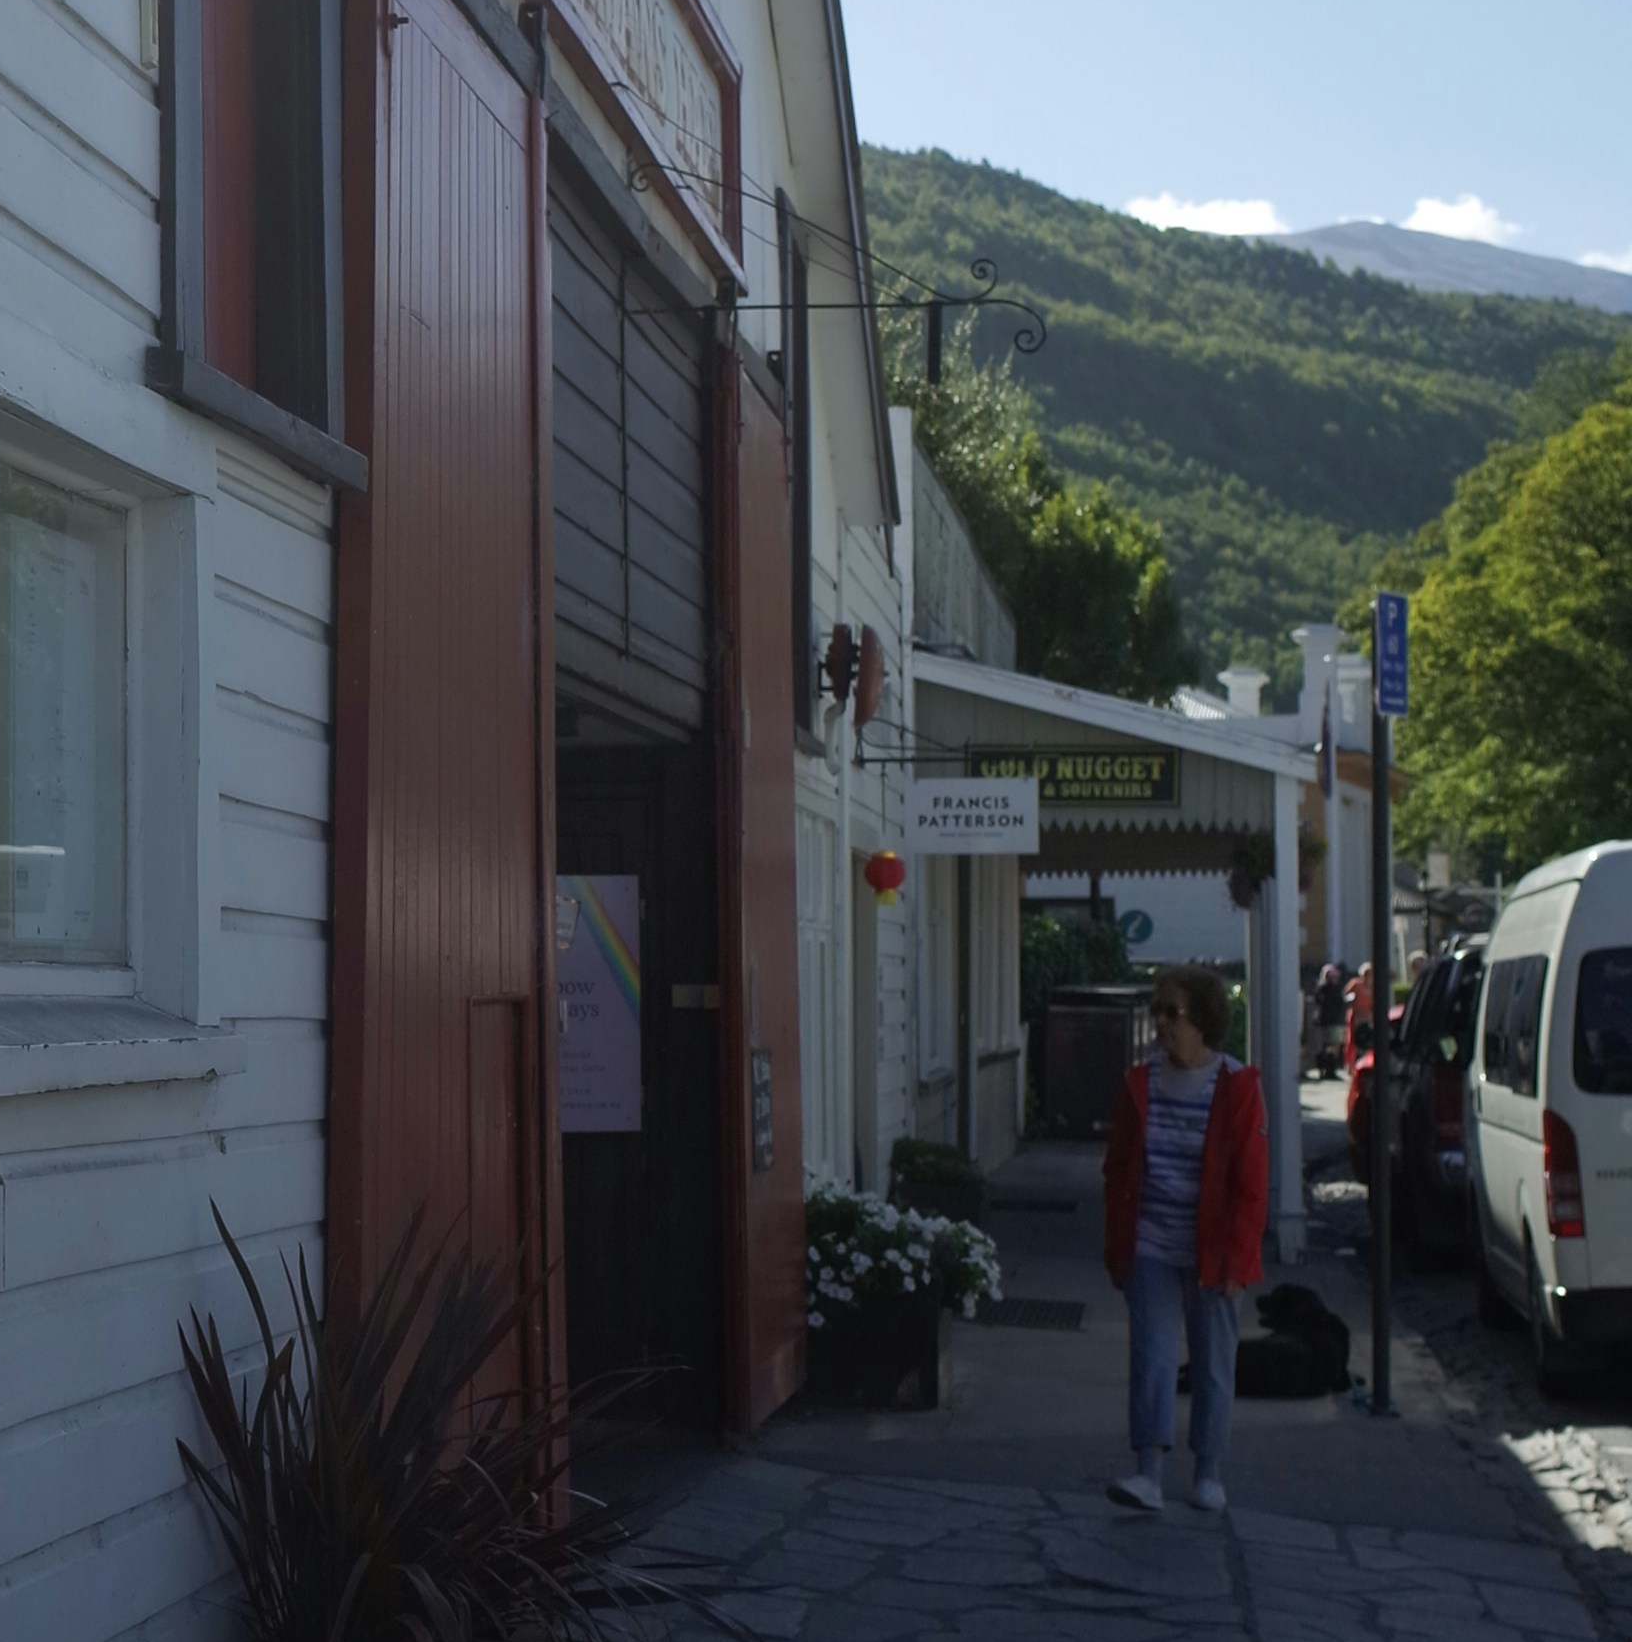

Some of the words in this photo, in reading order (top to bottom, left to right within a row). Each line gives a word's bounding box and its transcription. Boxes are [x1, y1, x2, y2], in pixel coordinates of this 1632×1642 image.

[1387, 600, 1399, 628] P
[1056, 755, 1165, 781] NUGGET
[1059, 781, 1153, 799] SOUVENIRS
[932, 796, 1010, 810] FRANCIS
[919, 814, 1025, 828] PATTERSON
